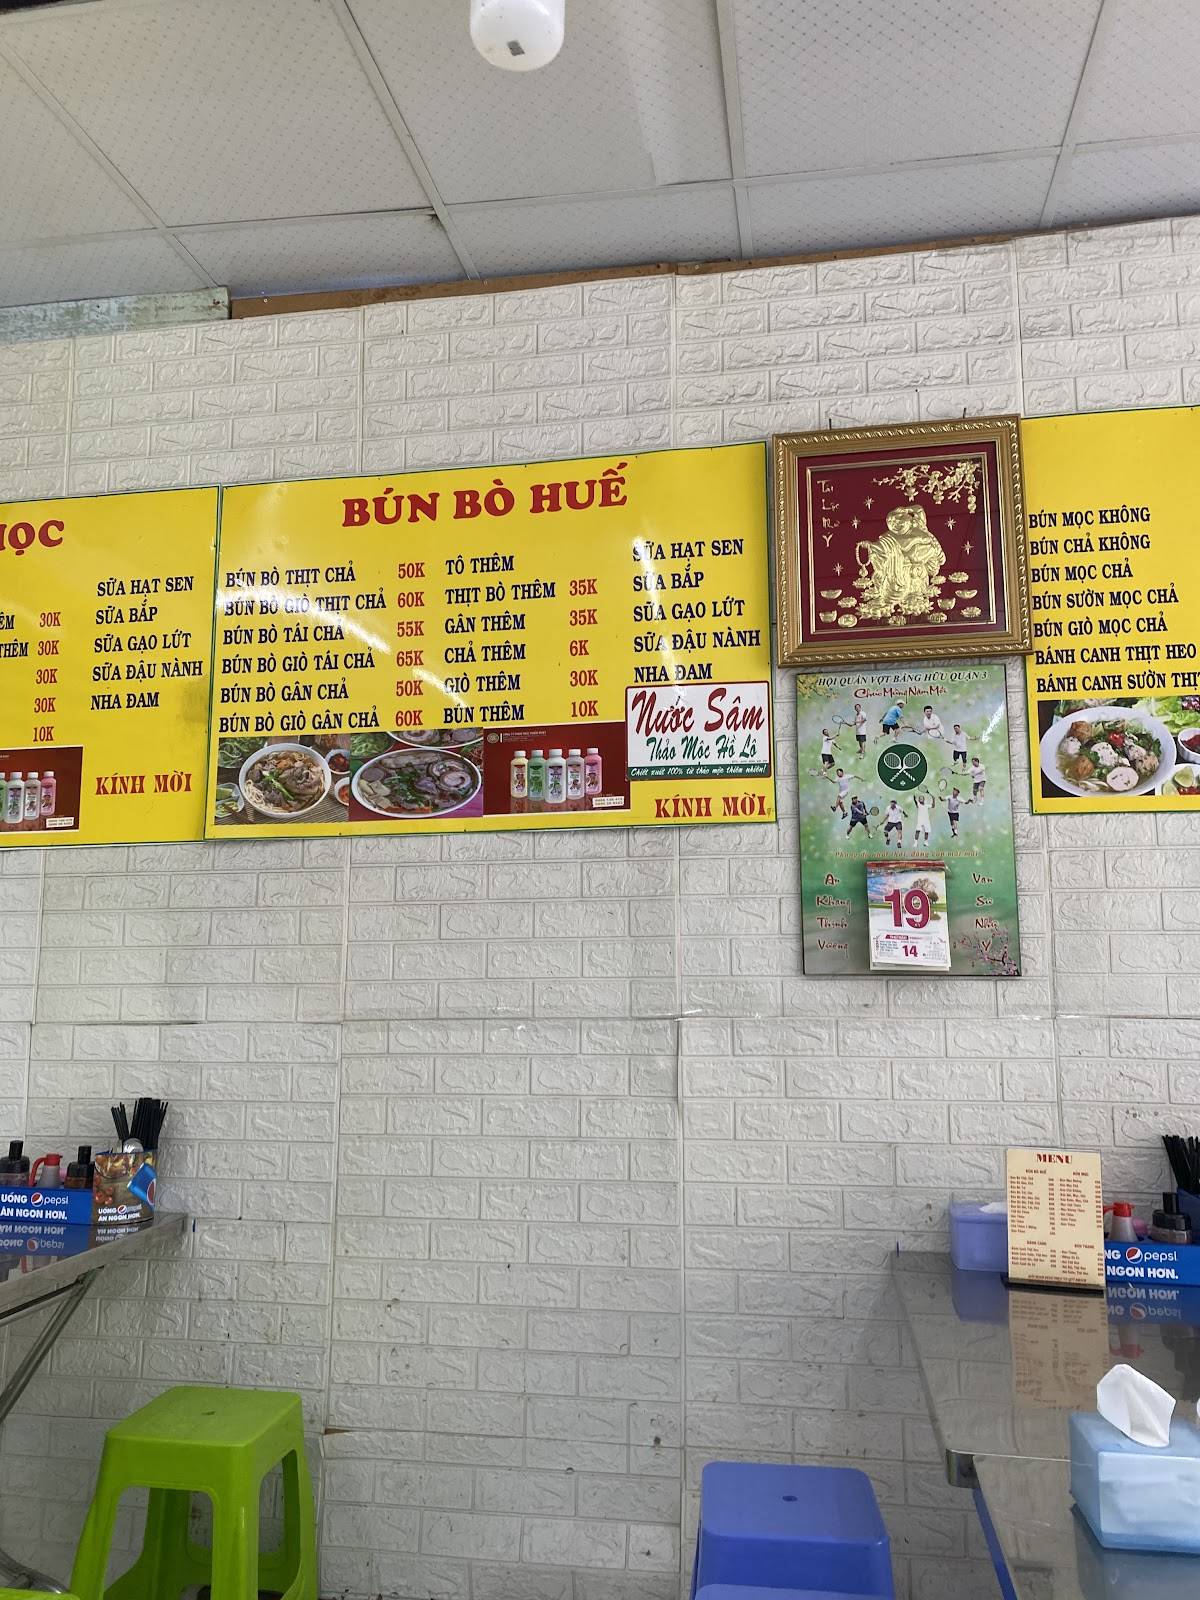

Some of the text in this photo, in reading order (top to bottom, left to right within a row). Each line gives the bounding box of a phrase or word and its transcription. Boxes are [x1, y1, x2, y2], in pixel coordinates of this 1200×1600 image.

[342, 462, 628, 527] BÚN BÒ HUẾ
[1029, 504, 1150, 529] BÚN MỌC KHÔNG
[0, 519, 65, 556] ỌC
[1030, 532, 1150, 555] BÚN CHẢ KHÔNG
[671, 541, 706, 562] HẠT
[712, 539, 744, 556] SEN
[226, 561, 425, 588] BÚN BÒ THỊT CHẢ 50K
[446, 553, 514, 575] TÔ THÊM
[671, 563, 704, 588] BẮP
[1032, 558, 1133, 583] BÚN MỌC CHẢ
[97, 576, 194, 597] SỮA HẠT SEN
[446, 579, 598, 607] THỊT BÒ THÊM 35K
[1033, 583, 1179, 610] BÚN SƯỜN MỌC CHẢ
[96, 599, 158, 625] SỮA BẮP
[224, 597, 254, 616] BÚN
[259, 594, 278, 615] BÒ
[315, 595, 350, 614] THỊT
[355, 587, 386, 610] CHẢ
[397, 592, 424, 608] 60K
[634, 596, 745, 622] SỮA GẠO LỨT
[40, 612, 61, 628] 30K
[445, 609, 598, 634] GÂN THÊM 35K
[1034, 611, 1168, 637] BÚN GIÒ MỌC CHẢ
[94, 630, 191, 654] SỮA GẠO LỨT
[223, 625, 253, 646] BÚN
[258, 623, 277, 644] BÒ
[283, 621, 308, 643] TÁI
[396, 622, 424, 638] 55K
[634, 627, 761, 653] SỮA ĐẬU NÀNH
[37, 641, 59, 656] 30K
[222, 647, 424, 675] BÚN BÒ GIÒ TÁI CHẢ 65K
[444, 640, 589, 664] CHẢ THÊM 6K
[1035, 643, 1196, 665] BÁNH CANH THỊT HEO
[36, 669, 58, 684] 30K
[93, 659, 202, 684] SỮA ĐẬU NÀNH
[444, 670, 598, 694] GIÒ THÊM 30K
[634, 663, 712, 682] NHA ĐAM
[1037, 670, 1200, 692] BÁNH CANH SƯỜN THỊ
[91, 692, 159, 712] NHA ĐAM
[220, 677, 423, 703] BÚN BÒ GÂN CHẢ 50K
[34, 698, 56, 713] 30K
[443, 700, 598, 724] BÚN THÊM 10K
[632, 688, 764, 737] Nước Sâm
[219, 705, 423, 733] BÚN BÒ GIÒ GÂN CHẢ 60K
[32, 727, 54, 741] 10K
[646, 736, 676, 762] Thảo
[716, 734, 736, 759] Hồ
[739, 734, 757, 758] Lô
[96, 770, 192, 795] KÍNH MỜI
[655, 792, 766, 818] KÍNH MỜI
[884, 889, 930, 929] 19
[902, 945, 918, 957] 14
[1037, 1154, 1072, 1164] MENU
[16, 1208, 43, 1218] NGON
[44, 1196, 69, 1205] pepsi
[1105, 1250, 1177, 1262] NG pepsi
[1107, 1266, 1144, 1277] NGON
